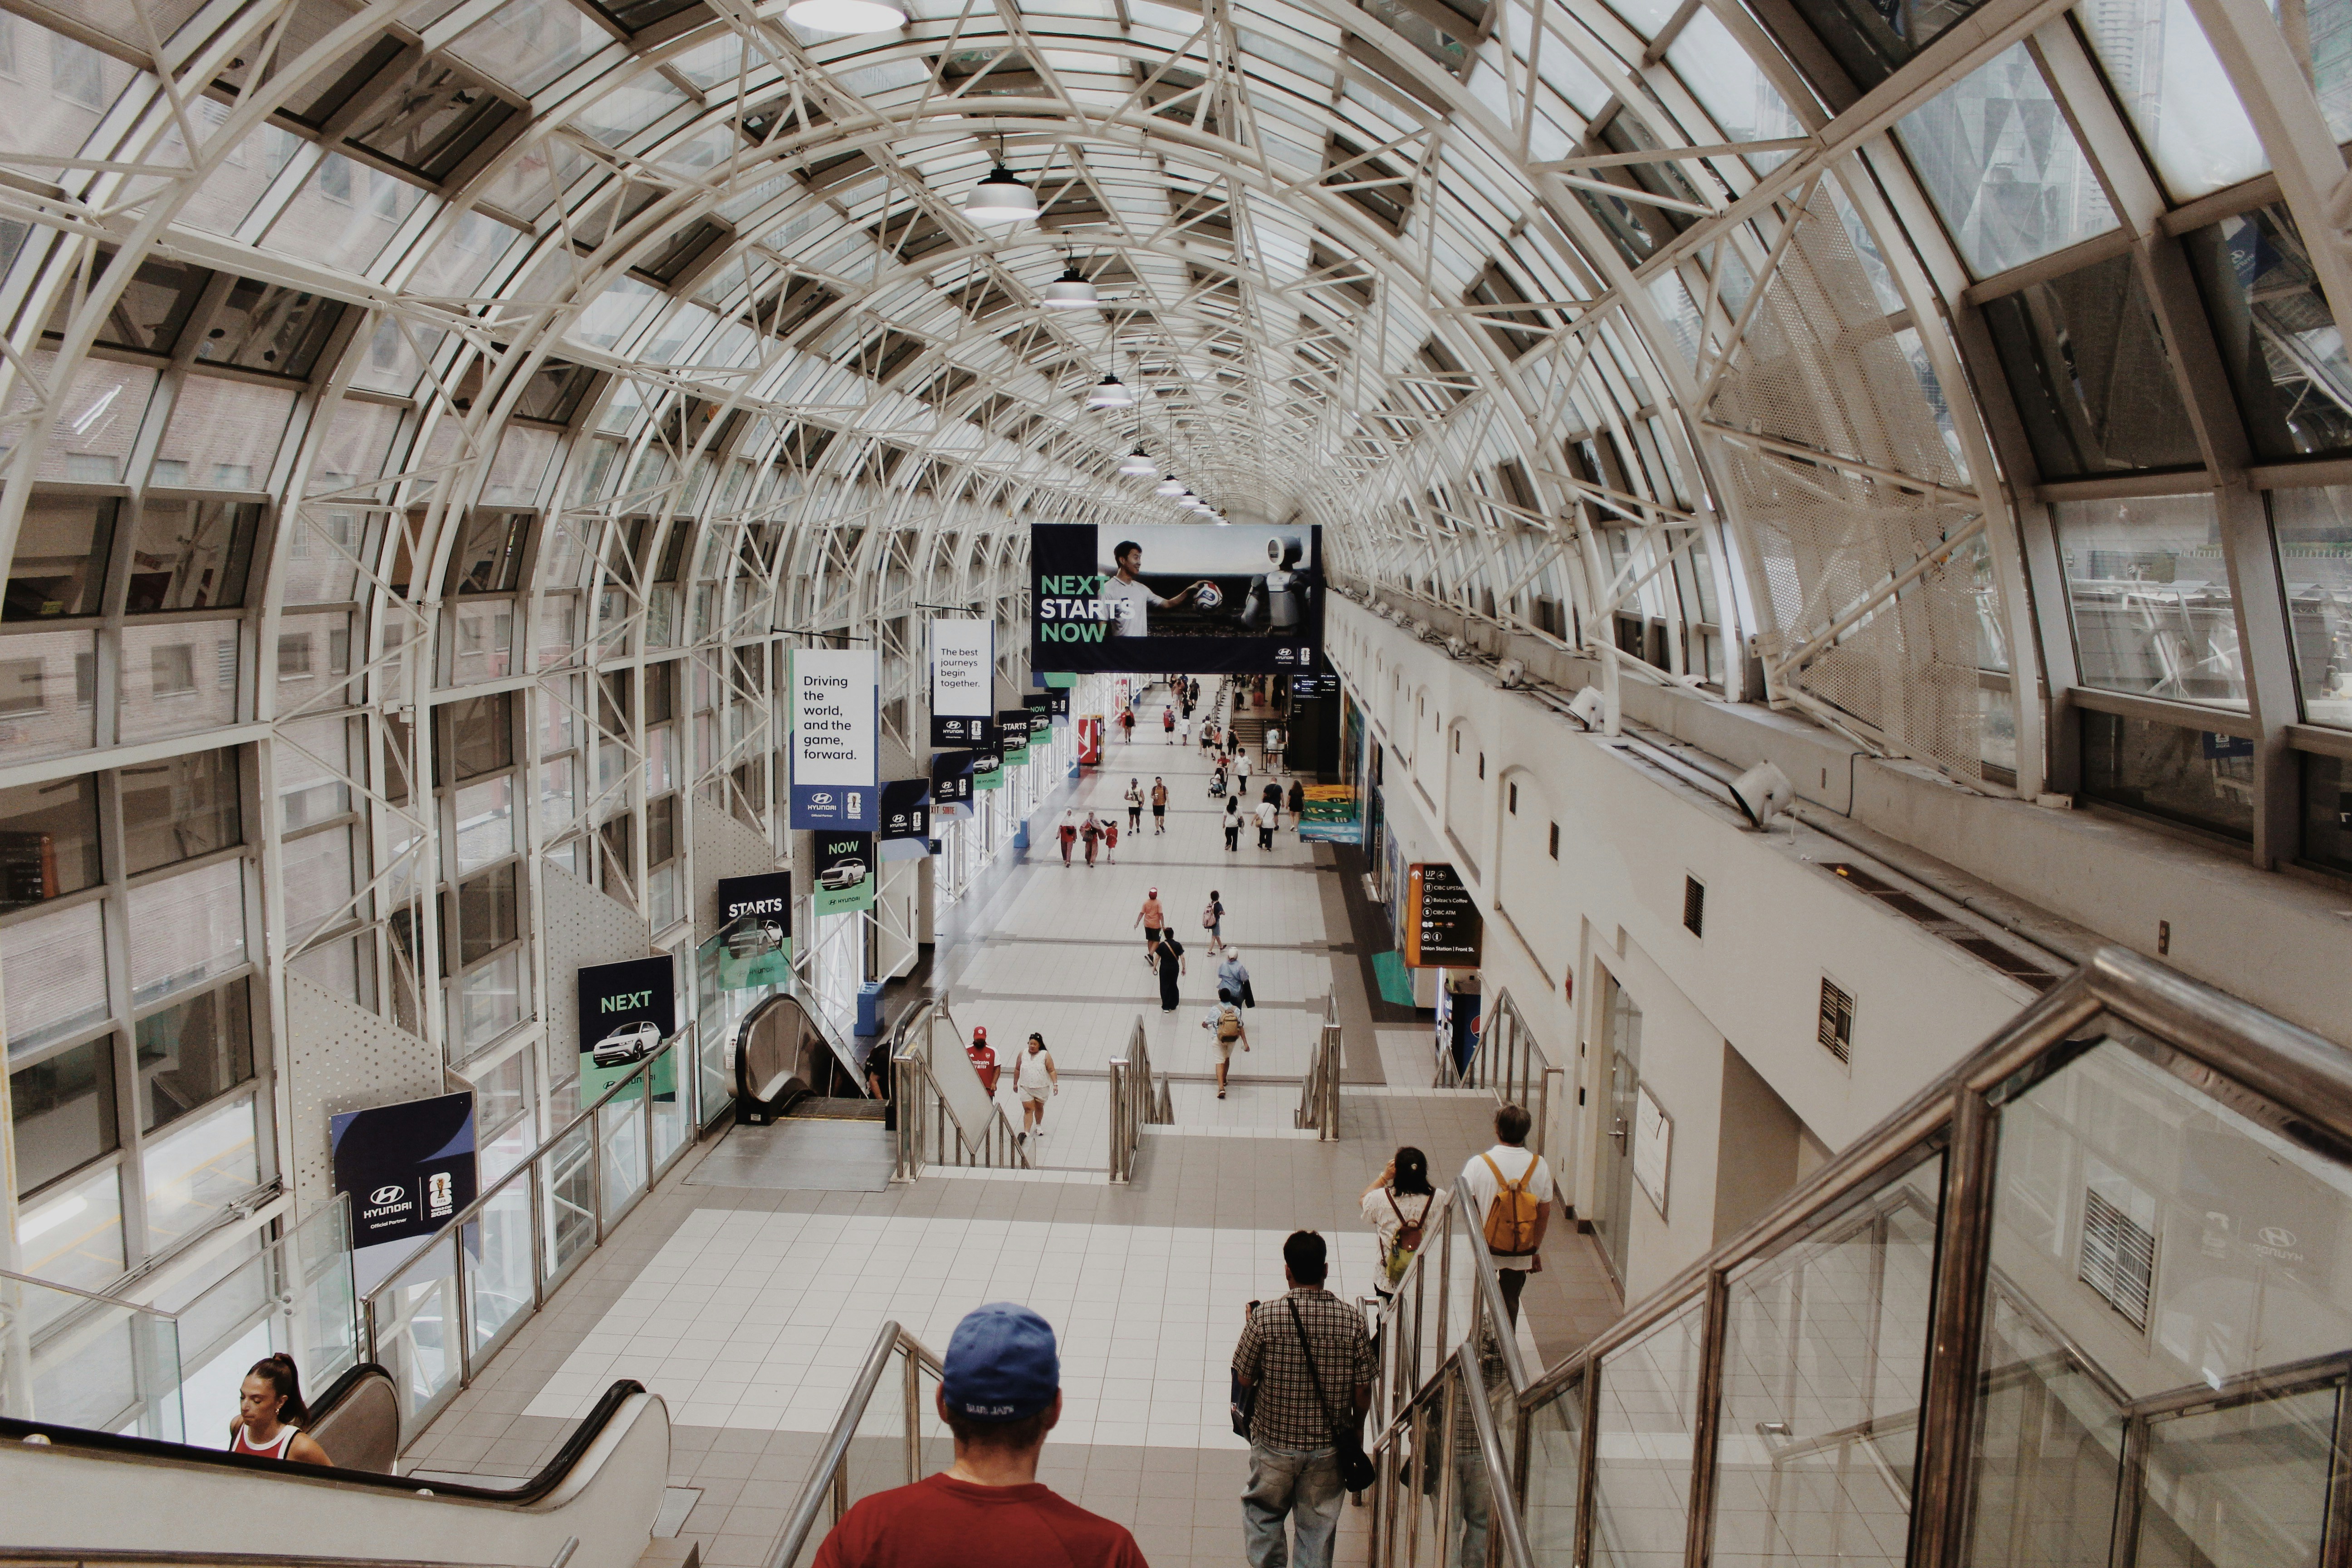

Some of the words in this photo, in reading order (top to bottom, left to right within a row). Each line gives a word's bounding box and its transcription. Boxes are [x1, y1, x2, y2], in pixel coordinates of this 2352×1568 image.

[1042, 575, 1110, 595] NEXT
[1040, 598, 1136, 620] STARTS
[1042, 622, 1107, 642] NOW
[941, 658, 977, 667] journeys
[941, 669, 965, 678] begin
[804, 676, 848, 688] Driving
[941, 680, 980, 688] together.
[804, 691, 824, 701] the
[804, 706, 843, 717] world,
[804, 720, 828, 730] and
[831, 720, 851, 730] the
[804, 737, 843, 747] game,
[804, 749, 857, 760] forward.
[828, 841, 859, 855] NOW
[729, 898, 783, 917] STARTS
[601, 990, 652, 1014] NEXT
[363, 1201, 412, 1219] HYUNDAI
[431, 1209, 453, 1218] 2026
